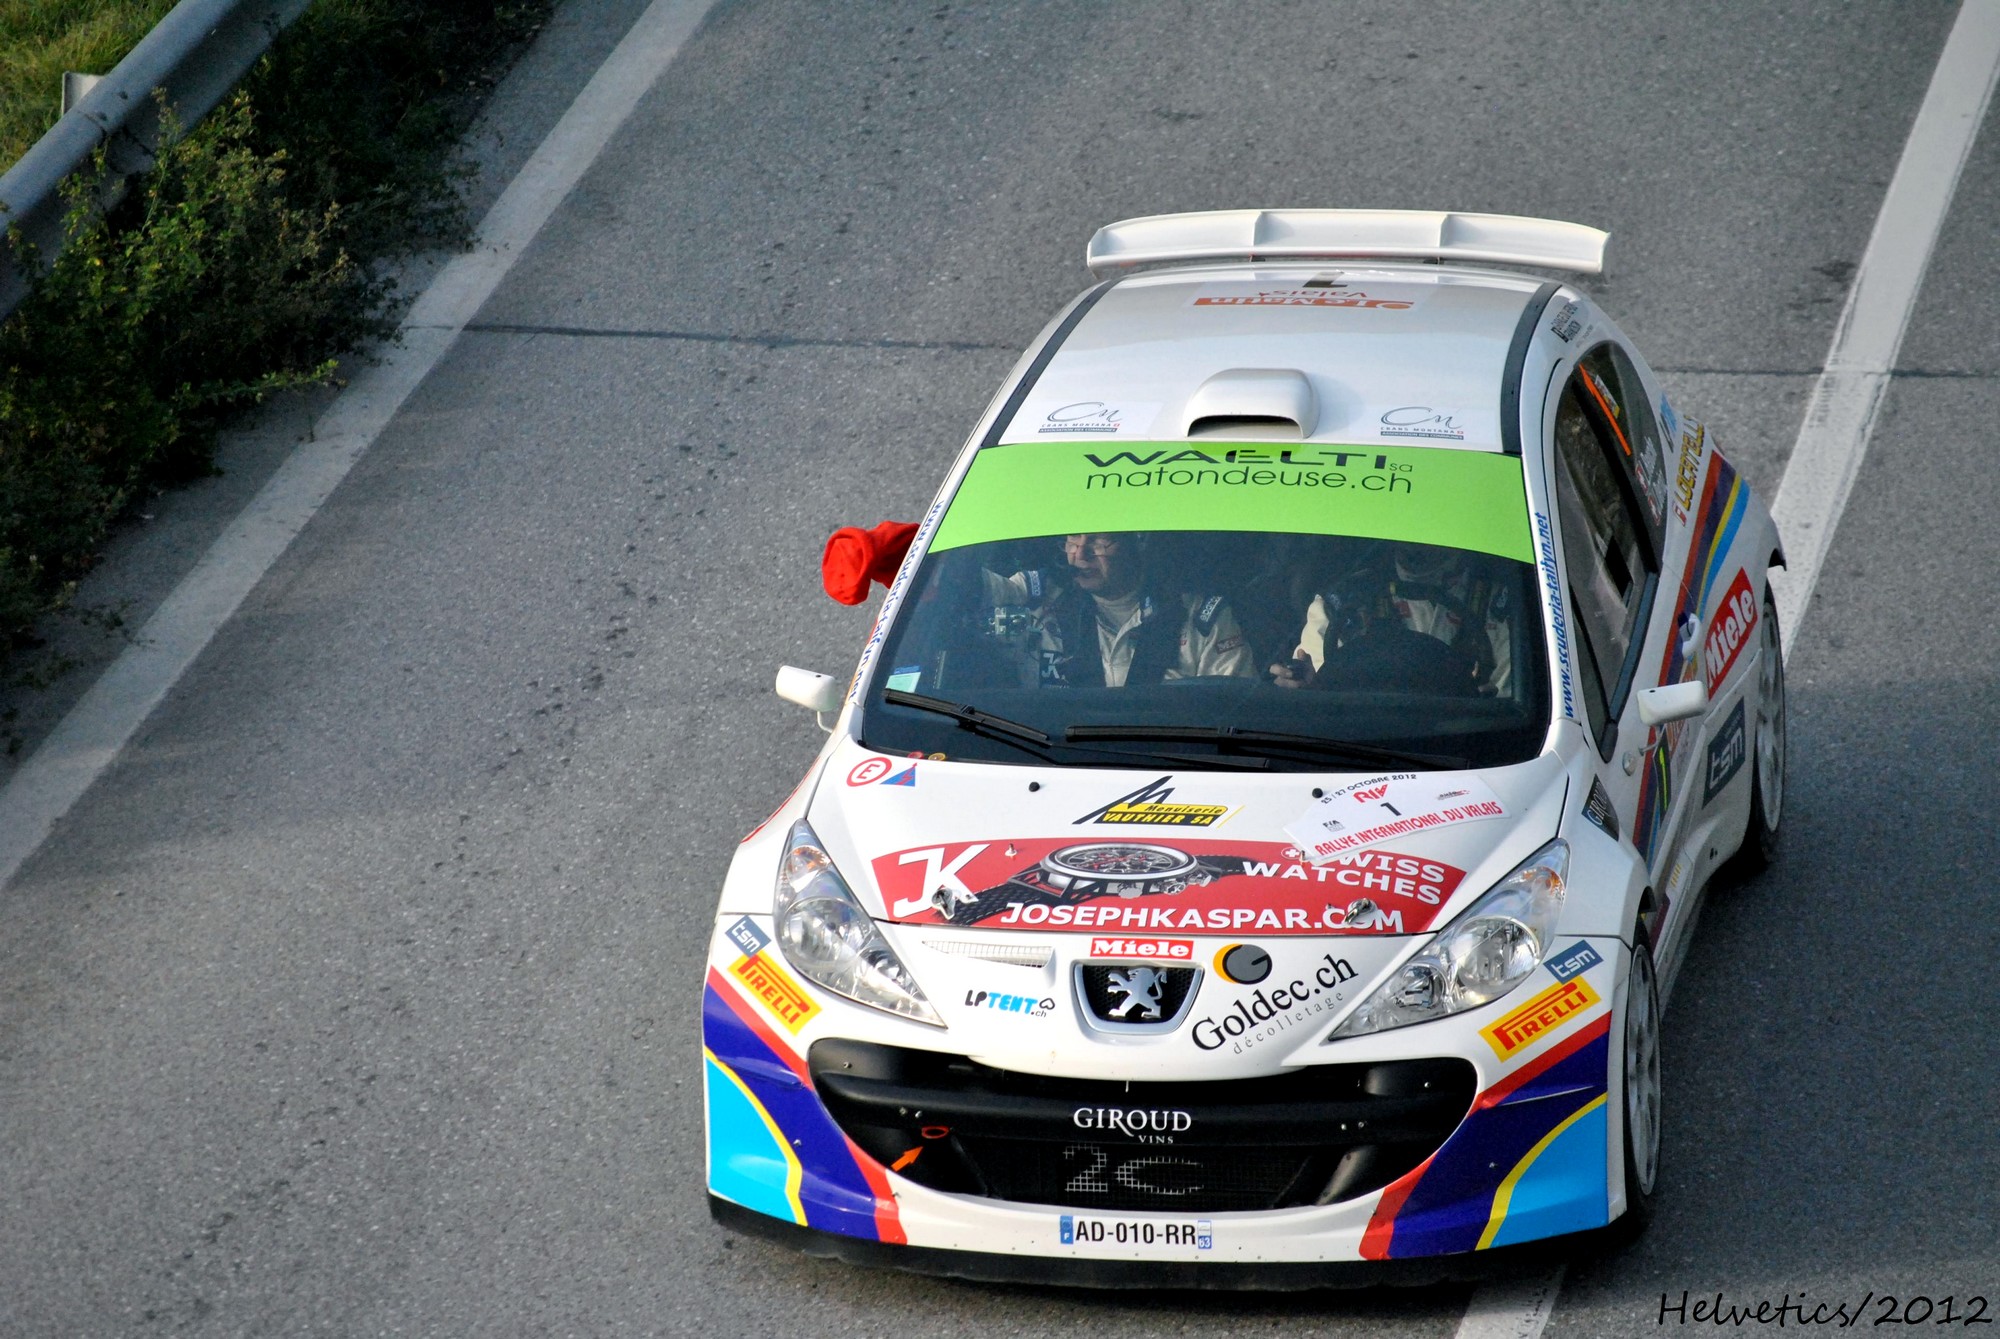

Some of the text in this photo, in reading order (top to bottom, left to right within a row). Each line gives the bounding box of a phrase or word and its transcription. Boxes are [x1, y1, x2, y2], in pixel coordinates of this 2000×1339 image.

[1084, 449, 1413, 472] WAELTI sa
[1087, 466, 1413, 494] matondeuse.ch
[1534, 512, 1574, 718] www.scuderia-taifyn.net
[1705, 587, 1755, 689] Miele
[1710, 724, 1743, 789] tsm
[1347, 776, 1390, 791] OCTOBRE
[1102, 813, 1214, 825] VAUTHIER SA
[1145, 804, 1223, 814] Menuiserie
[1322, 819, 1341, 828] FIA
[1380, 802, 1402, 817] 1
[1315, 801, 1503, 856] RALLYE INTERNATIONAL DU VALAIS
[892, 843, 991, 918] JK
[1335, 849, 1445, 884] WISS
[1243, 861, 1441, 905] WATCHES
[731, 921, 761, 953] tsm
[1092, 940, 1190, 958] Miele
[1551, 950, 1596, 978] tsm
[738, 954, 810, 1024] PIRELLI
[1192, 954, 1359, 1050] Goldec.ch
[1233, 992, 1344, 1055] décolletage
[1493, 982, 1588, 1051] PIRELLI
[1073, 1107, 1192, 1137] GIROUD
[1138, 1134, 1174, 1144] VINS
[1075, 1220, 1197, 1246] AD-010-RR
